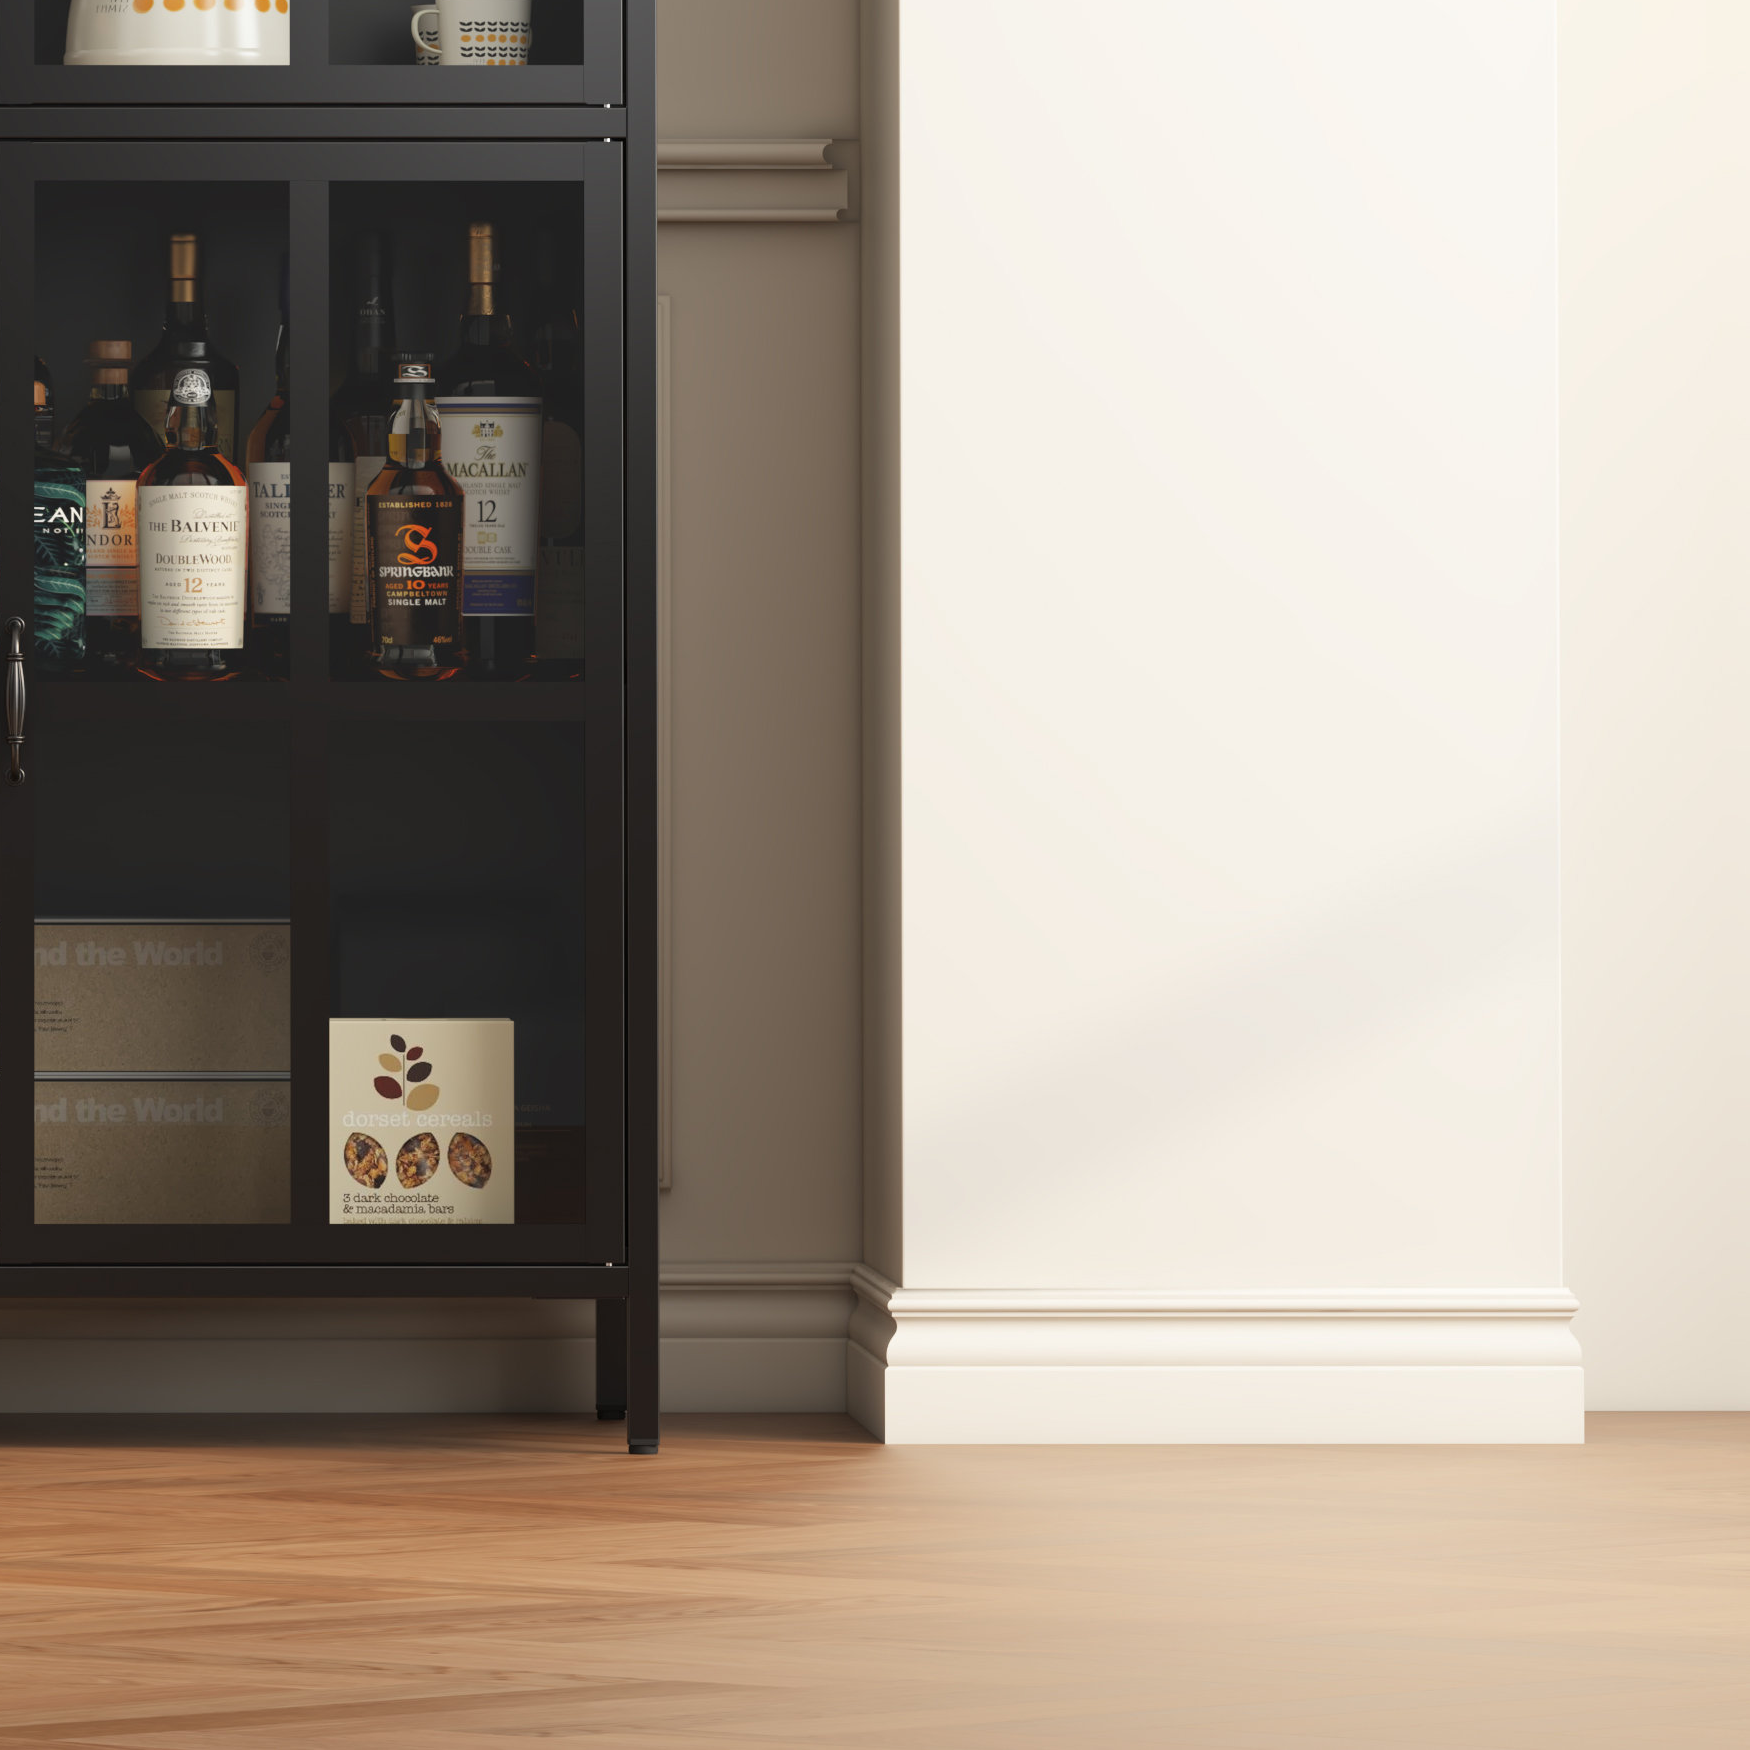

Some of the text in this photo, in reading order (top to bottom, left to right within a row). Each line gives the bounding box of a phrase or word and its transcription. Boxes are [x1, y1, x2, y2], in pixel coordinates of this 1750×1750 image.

[475, 445, 497, 461] The
[447, 462, 529, 478] MACALLAN
[169, 492, 218, 500] MALT SCOTCH
[378, 501, 432, 509] ESTABLISHED
[477, 499, 497, 523] 12
[148, 519, 240, 532] THE BALVENIE
[494, 546, 512, 554] CASK
[378, 565, 454, 578] SPRINGBANK
[184, 577, 203, 593] 12
[385, 579, 449, 591] AGED 10 YEARS
[386, 590, 448, 598] CAMPBELTOWN
[387, 597, 446, 606] SINGLE MALT
[75, 940, 224, 967] the World
[75, 1097, 224, 1123] the World
[342, 1111, 493, 1128] dorset cereals
[343, 1193, 439, 1203] 3 dark chocolate
[343, 1204, 455, 1215] & macadamia bars
